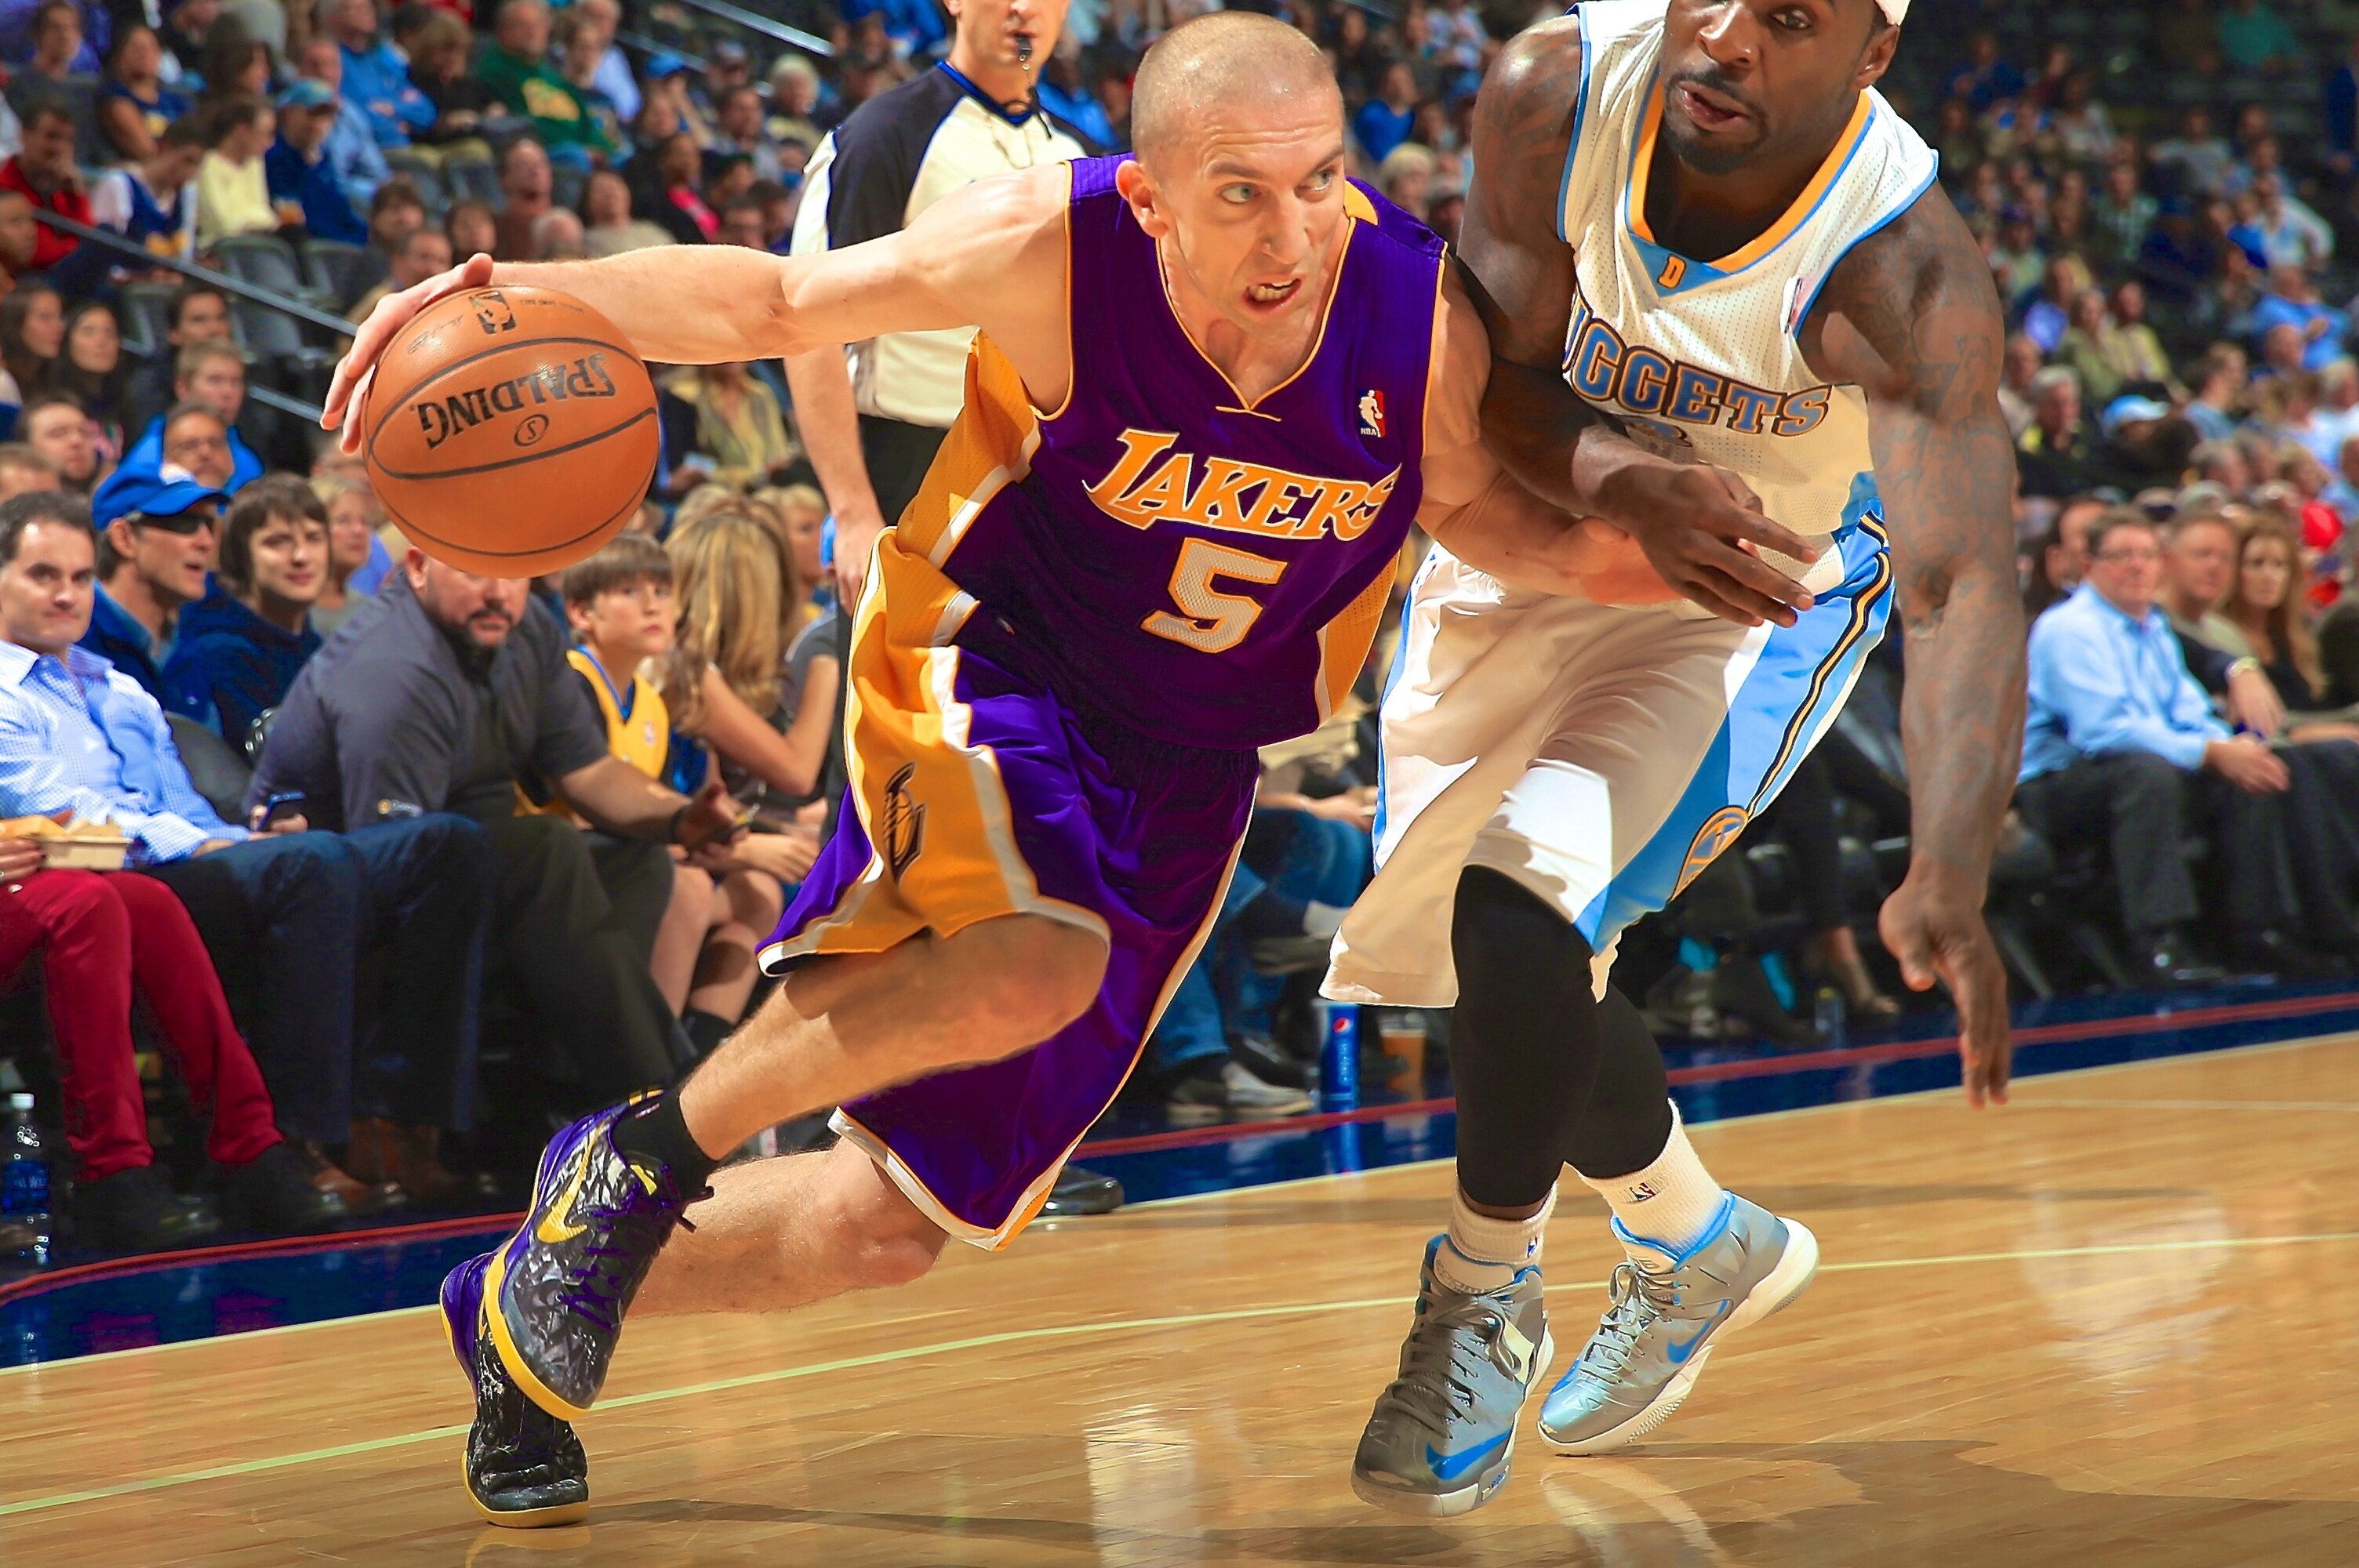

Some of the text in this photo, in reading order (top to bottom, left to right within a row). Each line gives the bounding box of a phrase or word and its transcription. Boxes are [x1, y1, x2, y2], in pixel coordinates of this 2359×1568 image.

[1657, 253, 1687, 289] D
[417, 352, 616, 451] SPALDING
[1360, 427, 1377, 436] NBA
[1082, 427, 1402, 541] LAKERS
[1140, 537, 1288, 654] 5
